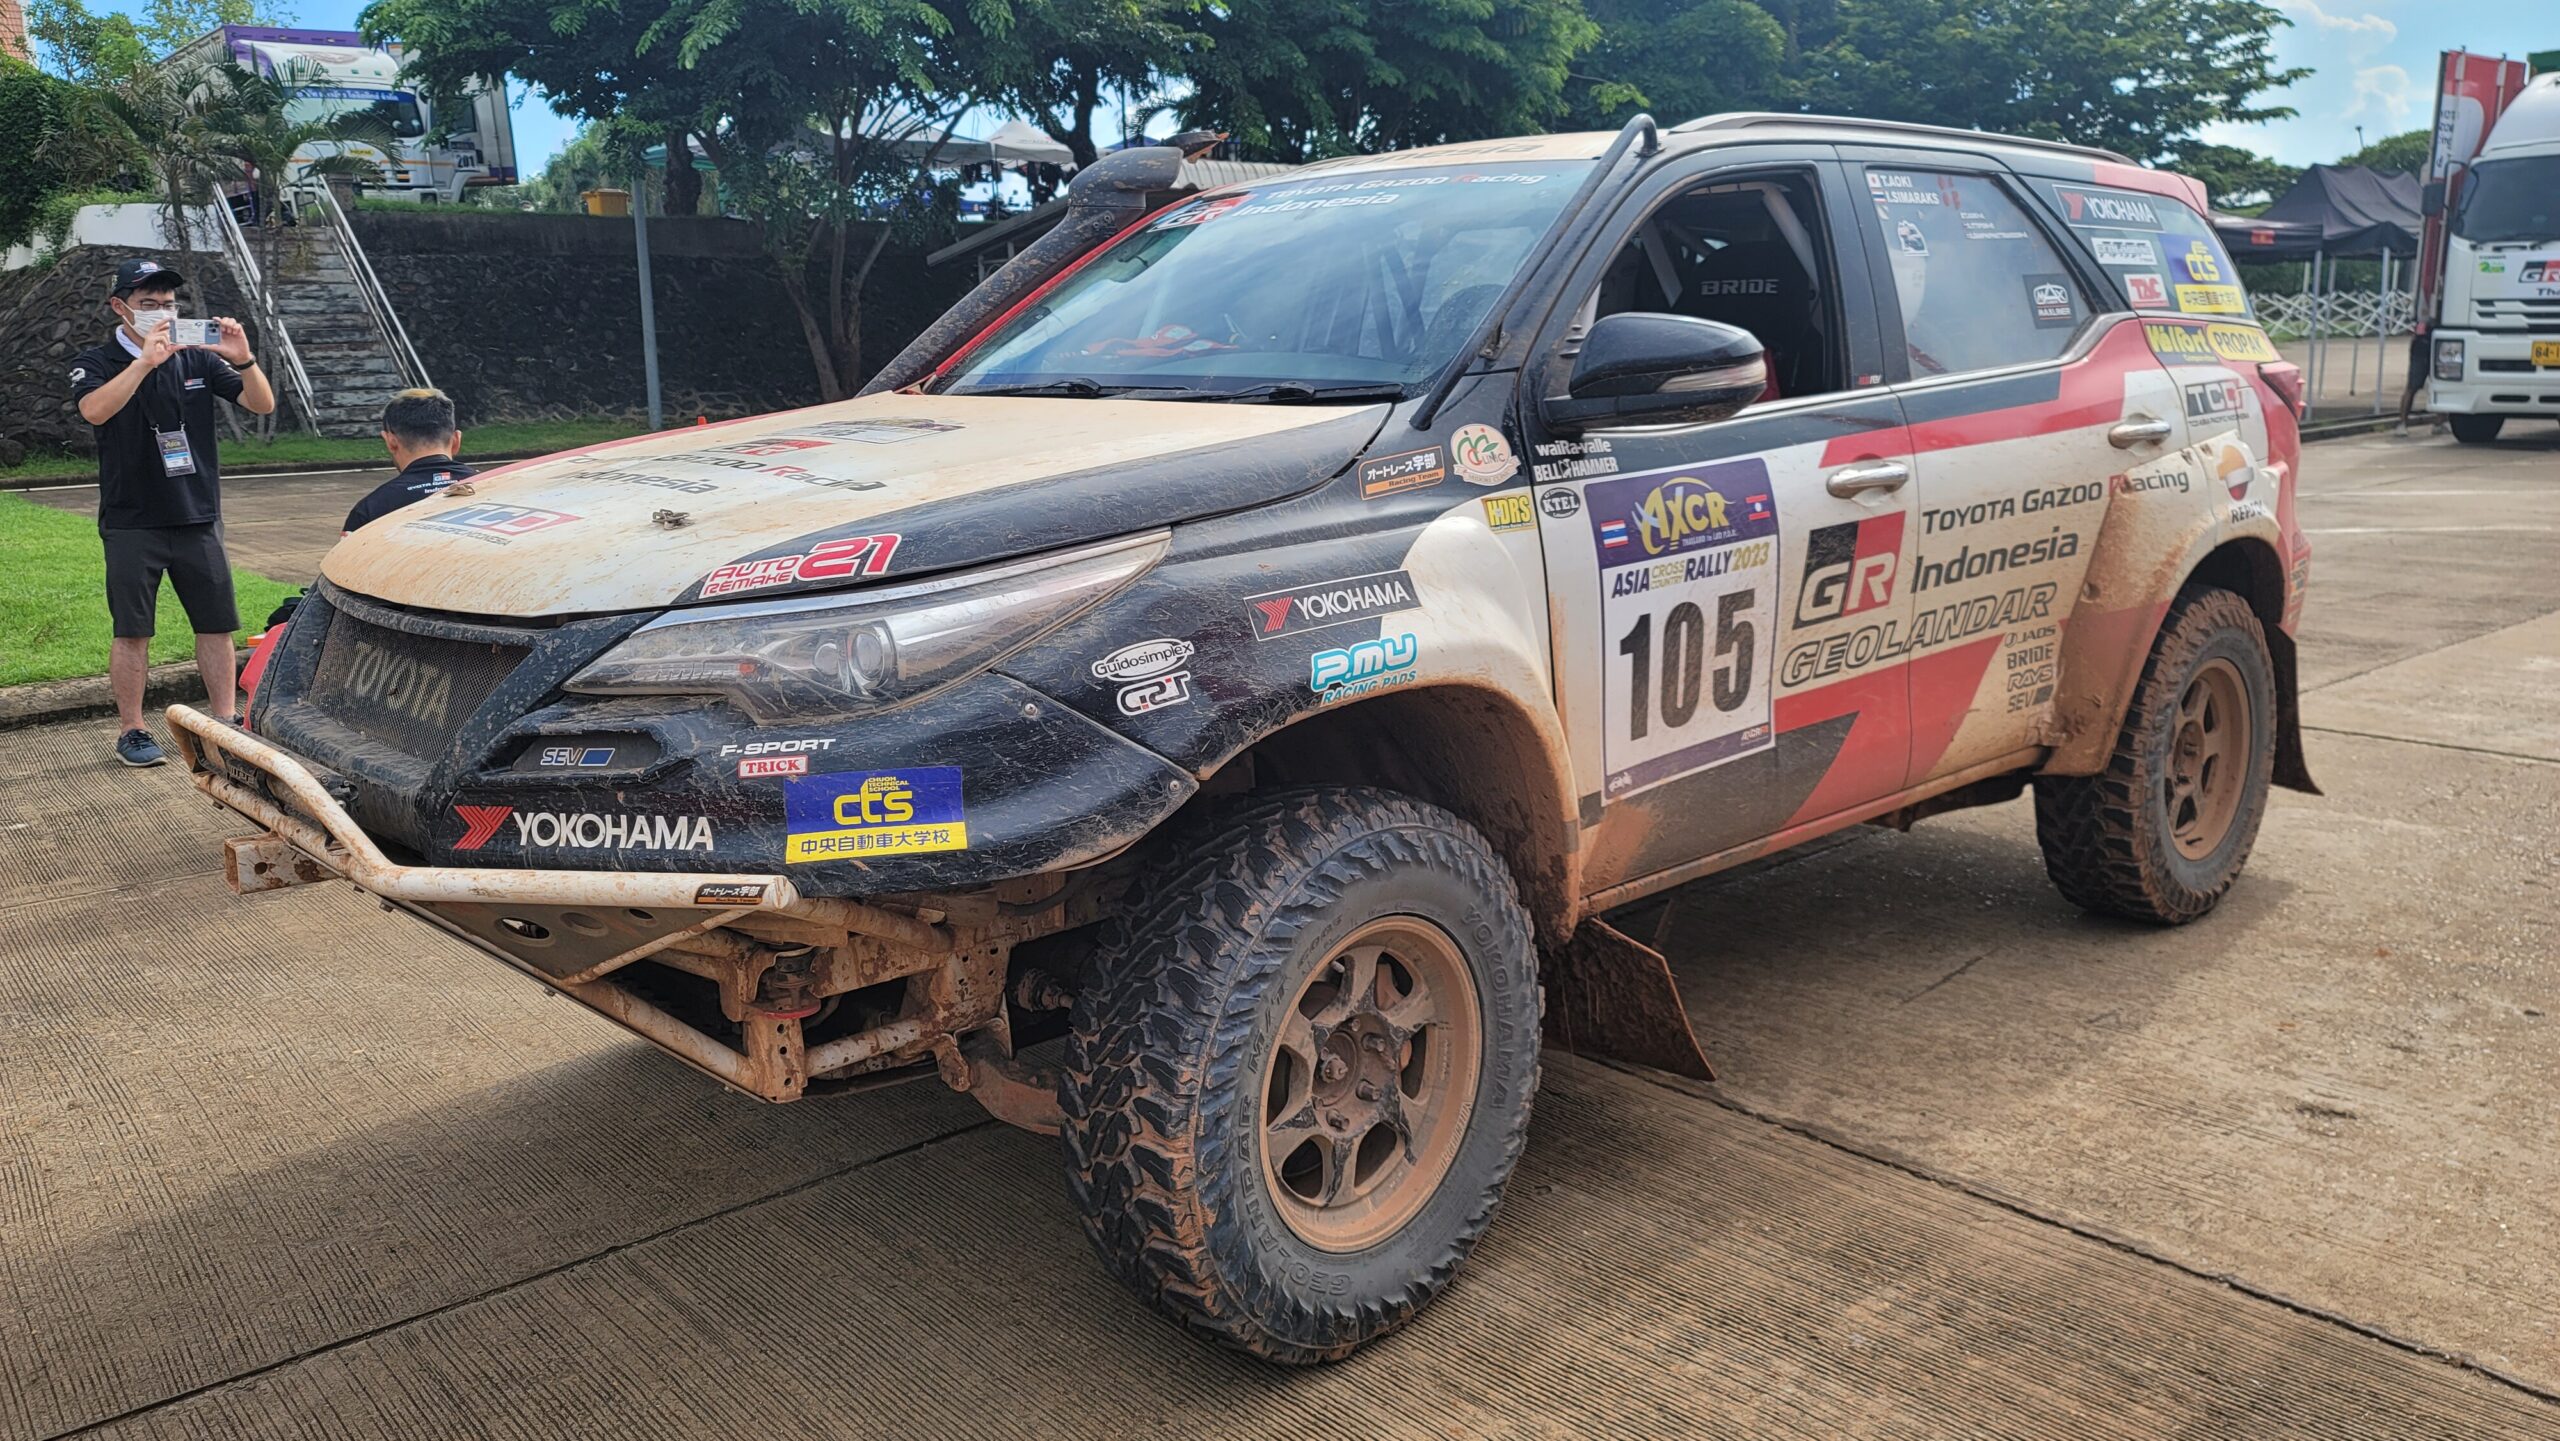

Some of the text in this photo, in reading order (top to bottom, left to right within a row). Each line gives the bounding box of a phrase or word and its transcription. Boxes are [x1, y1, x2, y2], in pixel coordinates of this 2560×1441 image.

[456, 154, 476, 168] 201
[1266, 172, 1548, 200] TOYOTA GAZOO Racing
[1880, 175, 1913, 188] T.AOKI
[1231, 191, 1400, 217] Indonesia
[2083, 196, 2158, 224] YOKOHAMA
[1700, 278, 1780, 296] BRIDE
[2212, 331, 2270, 358] PROPAK
[1534, 439, 1612, 457] waiRa-valle
[1367, 453, 1437, 481] オートレース宇部
[1388, 471, 1440, 487] Racing Team
[1533, 456, 1619, 483] BELL HAMMER
[1543, 496, 1580, 513] KTEL
[1922, 470, 2190, 535] TOYOTA GAZOO Racing
[709, 556, 800, 582] AUTO
[796, 533, 902, 580] 21
[1611, 541, 1771, 599] ASIA CROSS RALLY 2023
[1909, 526, 2079, 594] Indonesia
[703, 571, 793, 596] REMAKE
[1797, 546, 1898, 626] GR
[1293, 580, 1412, 621] YOKOHAMA
[1780, 582, 2058, 688] GEOLANDAR
[2017, 624, 2057, 644] JAOS
[1094, 640, 1194, 678] Guidosimplex
[1619, 588, 1756, 742] 105
[2006, 641, 2055, 670] BRIDE
[344, 640, 453, 730] TOYOTA
[1322, 669, 1417, 704] RACING PADS
[2006, 663, 2053, 692] RAYS
[2006, 688, 2035, 714] SEV
[541, 747, 582, 766] SEV
[720, 738, 837, 757] F-SPORT
[745, 759, 801, 775] TRICK
[833, 778, 914, 826] cts
[512, 811, 715, 851] YOKOHAMA
[800, 829, 951, 856] 中央自動車大学校
[701, 885, 761, 898] オートレース宇部
[1461, 902, 1515, 1109] YOKOHAMA
